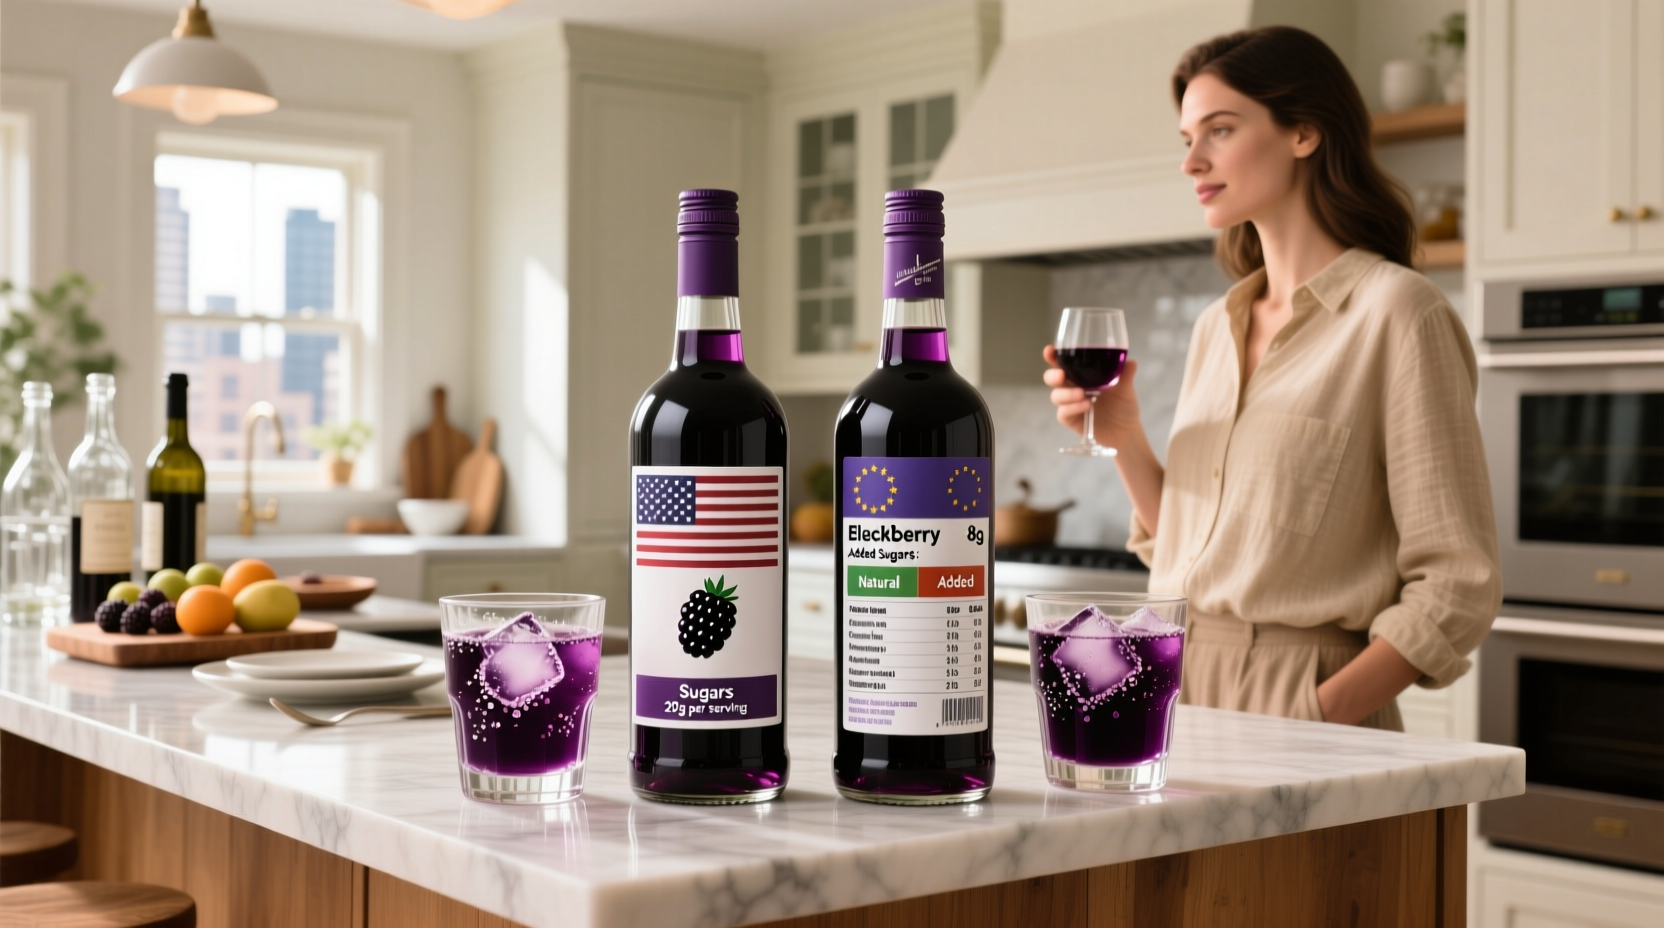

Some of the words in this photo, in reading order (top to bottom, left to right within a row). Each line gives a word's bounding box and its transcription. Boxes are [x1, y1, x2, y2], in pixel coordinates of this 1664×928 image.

[967, 525, 984, 545] 8g
[858, 575, 900, 589] Natural
[937, 574, 974, 589] Added
[679, 684, 734, 703] Sugars
[664, 701, 686, 717] 20g
[688, 705, 705, 717] per
[708, 703, 747, 715] serving
